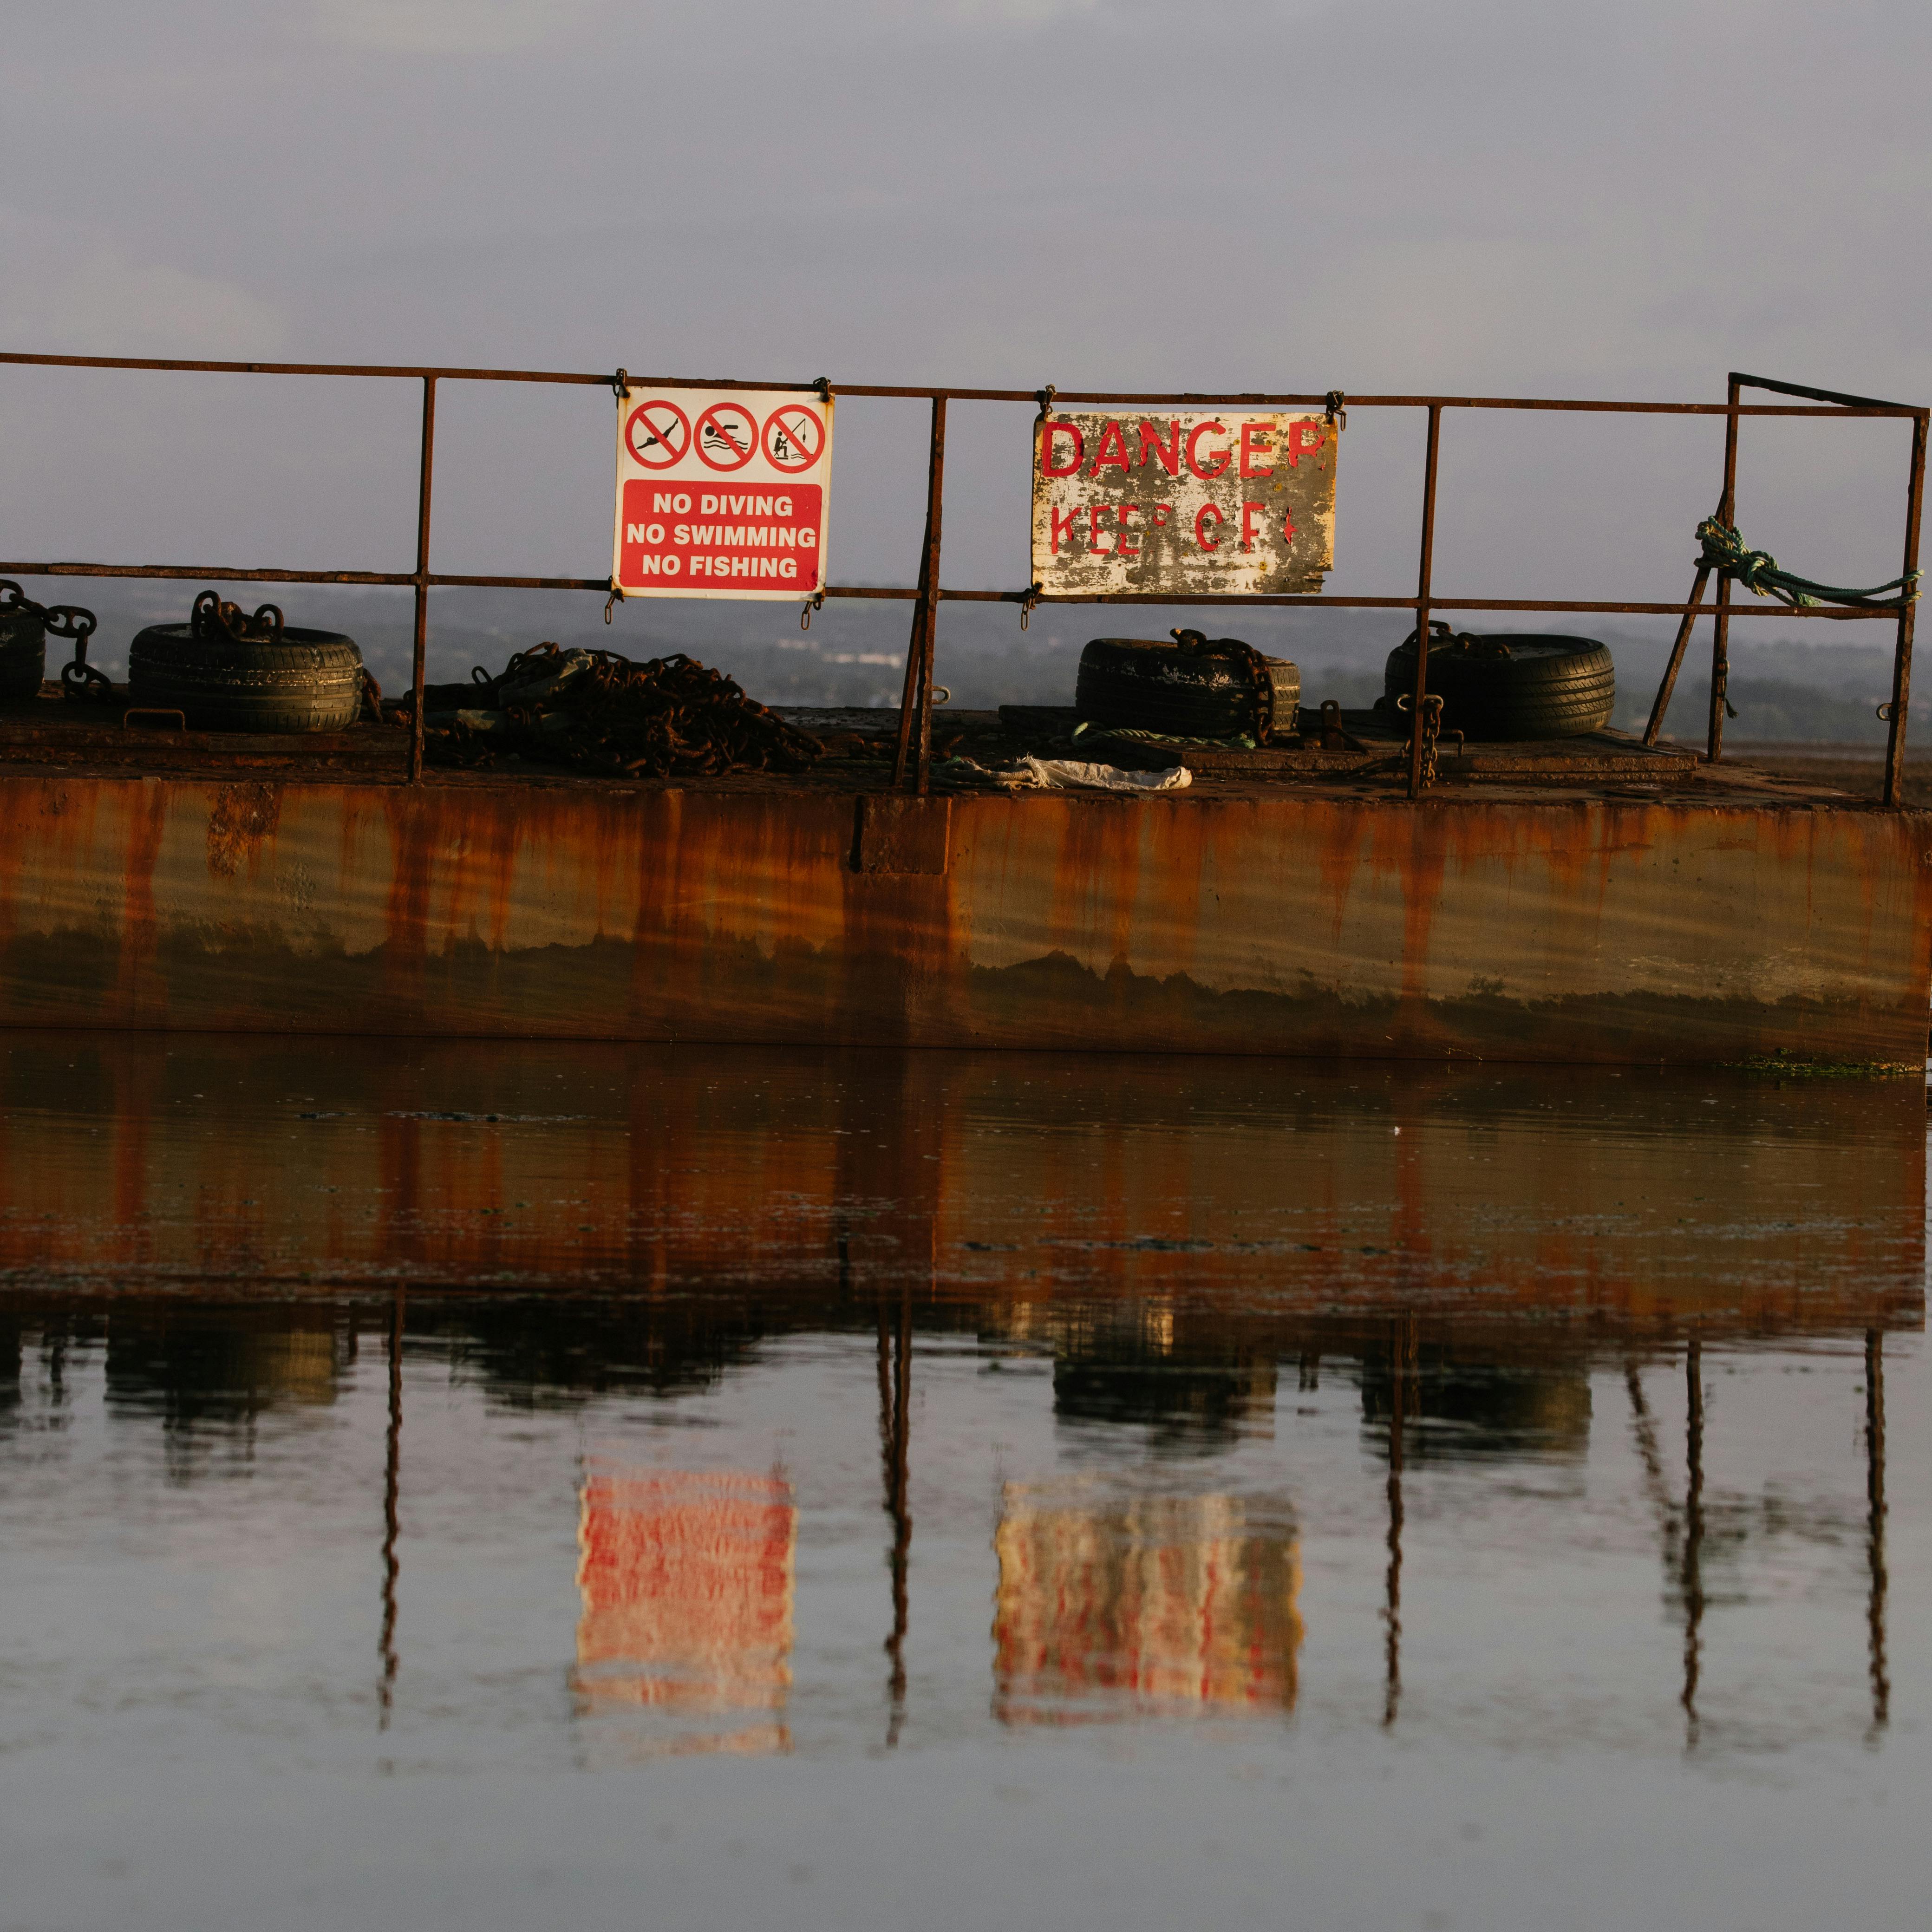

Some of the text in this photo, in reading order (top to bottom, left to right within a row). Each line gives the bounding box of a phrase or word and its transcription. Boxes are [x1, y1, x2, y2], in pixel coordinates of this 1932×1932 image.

[653, 493, 793, 516] NO DIVING
[627, 523, 816, 548] NO SWIMMING
[642, 555, 797, 578] NO FISHING
